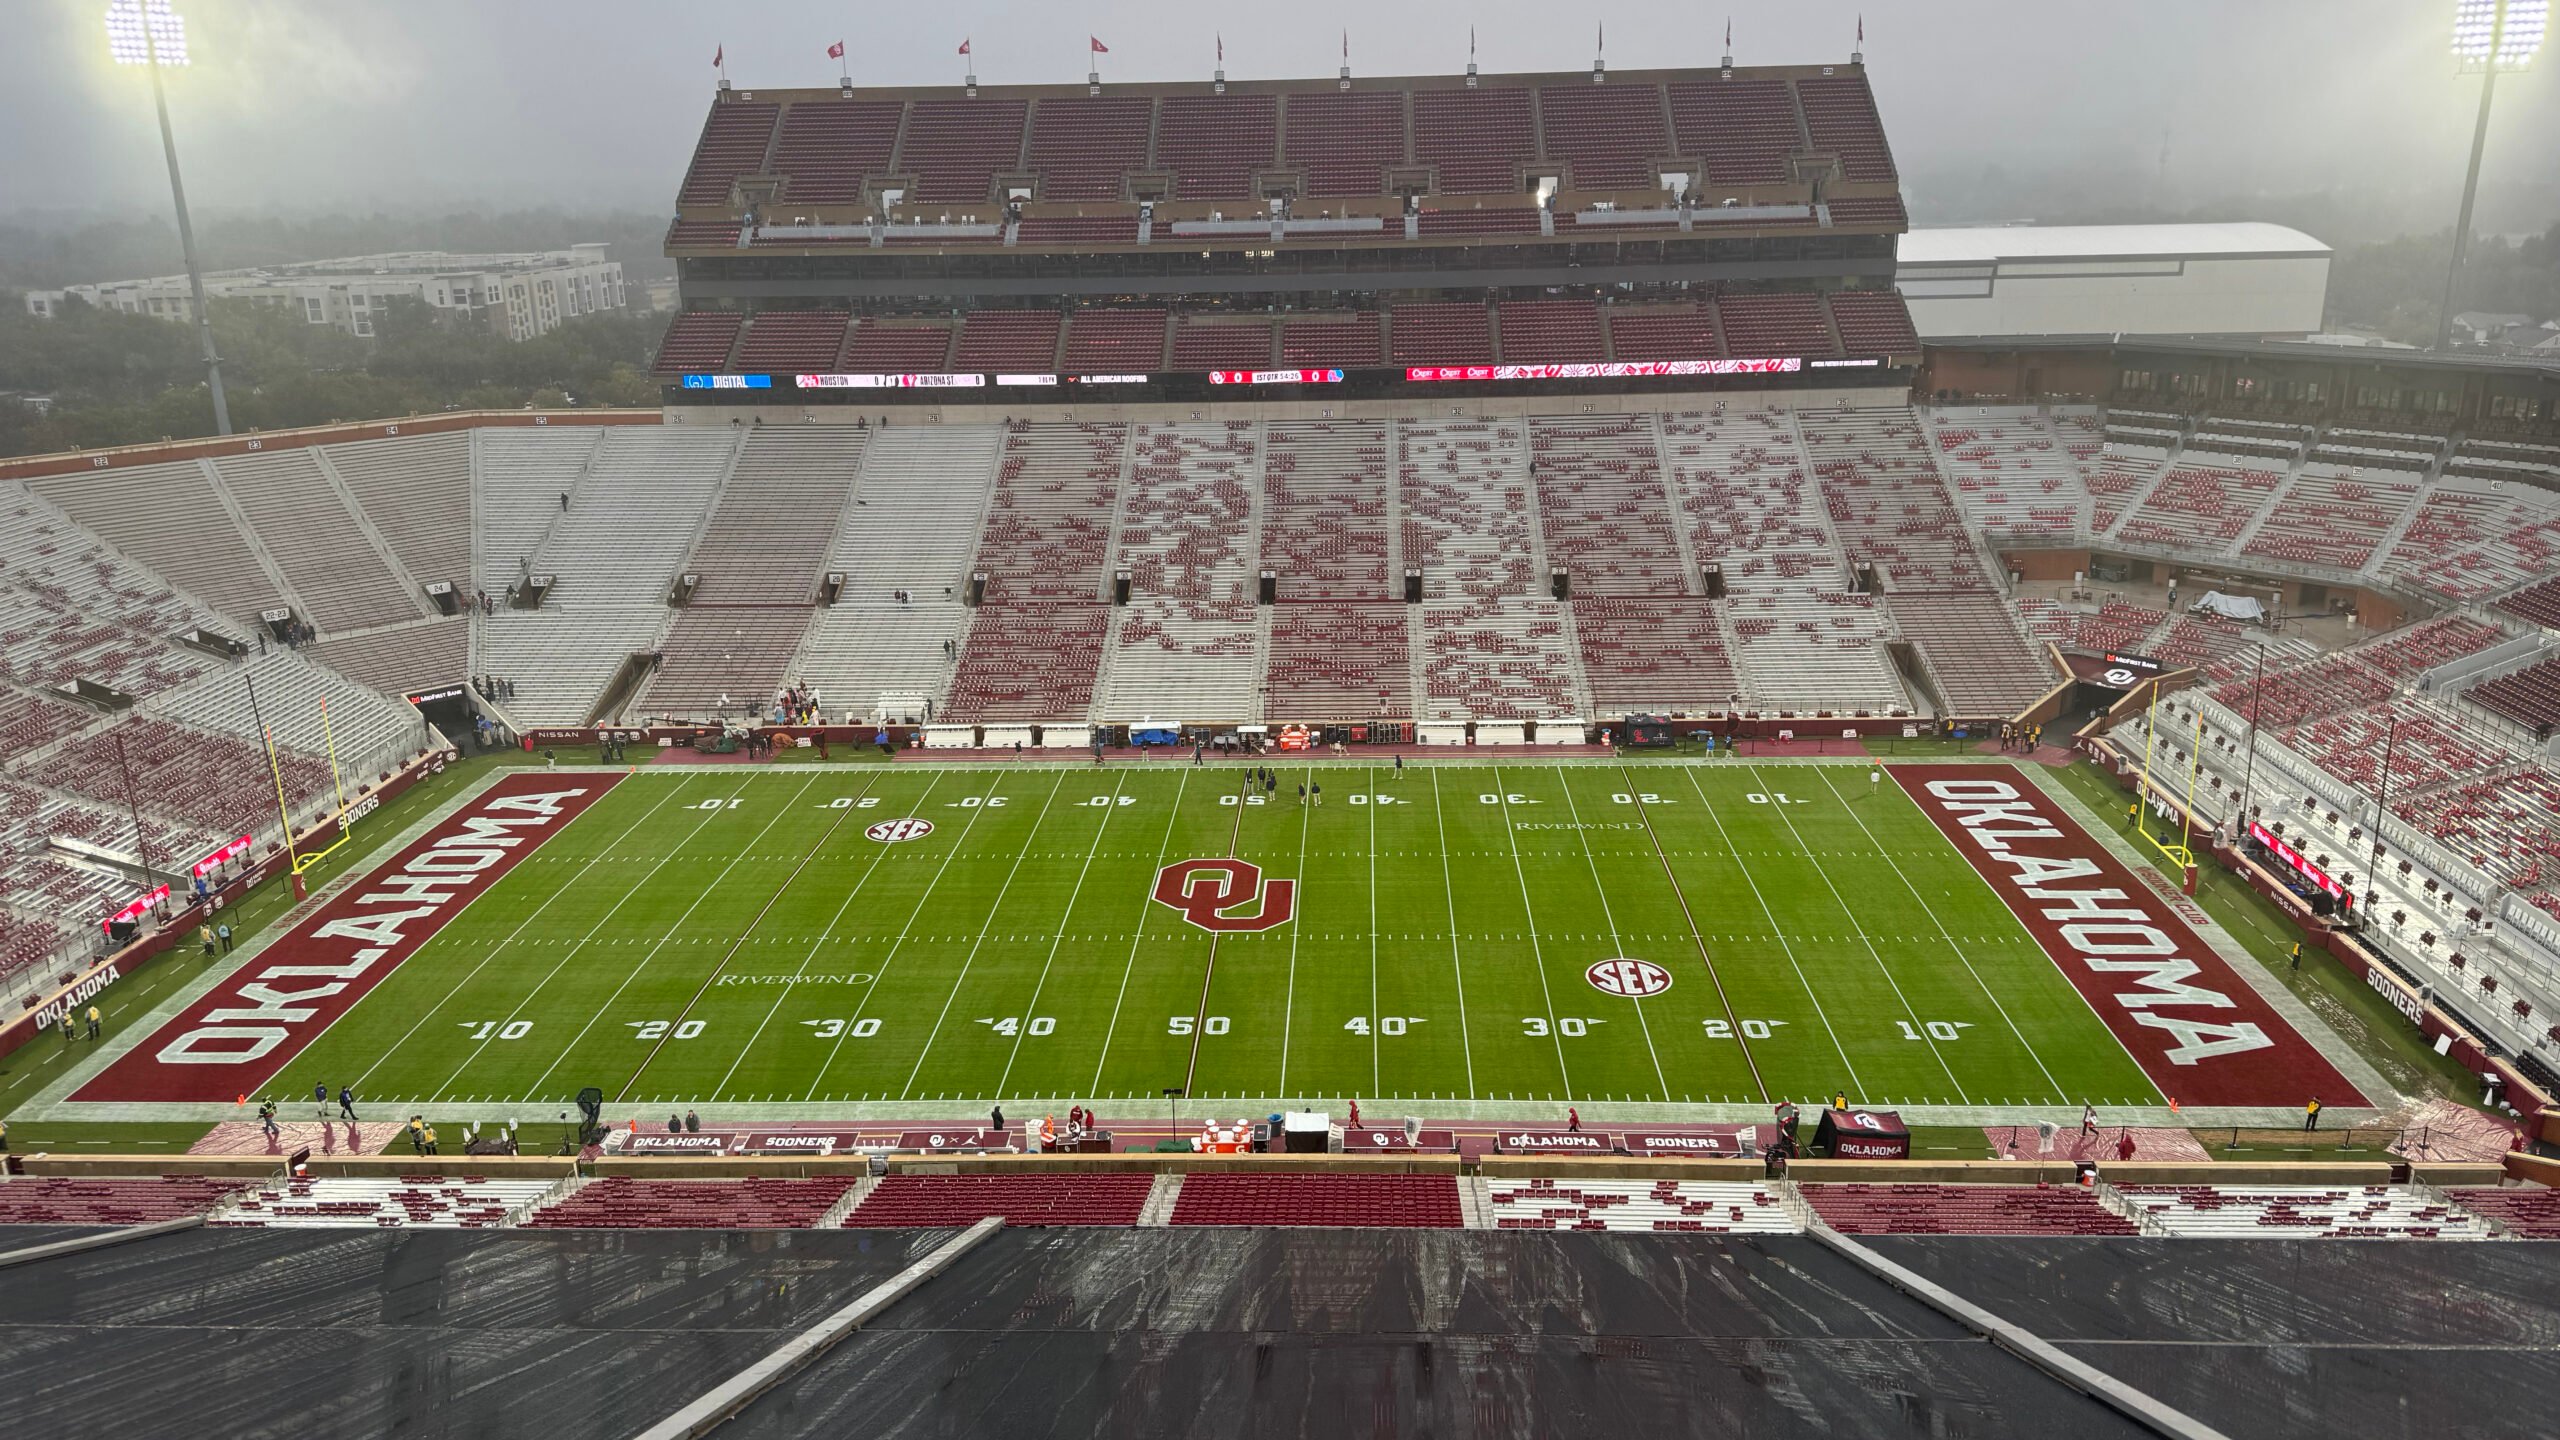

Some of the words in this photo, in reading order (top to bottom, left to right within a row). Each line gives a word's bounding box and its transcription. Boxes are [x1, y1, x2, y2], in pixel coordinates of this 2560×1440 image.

[713, 376, 748, 388] DIGITAL
[820, 376, 848, 386] HOUSTON
[920, 376, 945, 386] ARIZONA
[1080, 376, 1091, 384] ALL
[1122, 375, 1148, 383] ROOFING
[1280, 372, 1299, 380] 54:26
[265, 610, 287, 620] 22-23
[2104, 669, 2136, 684] OU
[698, 799, 744, 809] 10
[830, 798, 880, 808] 20
[960, 797, 1008, 808] 30
[1089, 796, 1136, 806] 40
[1219, 795, 1266, 806] 50
[1350, 795, 1396, 805] 40
[1480, 794, 1527, 804] 30
[1612, 794, 1662, 804] 20
[1746, 793, 1792, 804] 10
[2136, 780, 2179, 826] OKLAHMA
[338, 794, 379, 830] SOONERS
[869, 820, 929, 841] SEC
[1515, 822, 1645, 831] RIVERWIND
[1151, 858, 1296, 932] OU
[2270, 890, 2300, 918] NISSAN
[2174, 904, 2209, 924] CLUB
[154, 788, 588, 1064] OKLAHOMA
[1925, 780, 2275, 1066] OKLAHOMA
[716, 973, 874, 987] RIVERWIND
[1591, 962, 1666, 994] SEC
[35, 964, 120, 1030] OKLAHOMA
[2367, 968, 2424, 1026] SOONERS
[470, 1020, 534, 1040] 10
[635, 1020, 707, 1039] 20
[814, 1018, 883, 1038] 30
[992, 1017, 1056, 1036] 40
[1168, 1016, 1230, 1036] 50
[1344, 1016, 1406, 1036] 40
[1522, 1018, 1589, 1037] 30
[1702, 1019, 1772, 1039] 20
[1896, 1020, 1960, 1040] 10
[634, 1137, 721, 1148] OKLAHOMA
[766, 1137, 837, 1146] SOONERS
[929, 1134, 945, 1147] OU
[1373, 1132, 1389, 1146] OU
[1509, 1136, 1600, 1148] OKLAHOMA
[1645, 1138, 1719, 1148] SOONERS
[1207, 1145, 1216, 1153] G
[1236, 1145, 1245, 1153] G
[1840, 1143, 1902, 1156] OKLAHOMA
